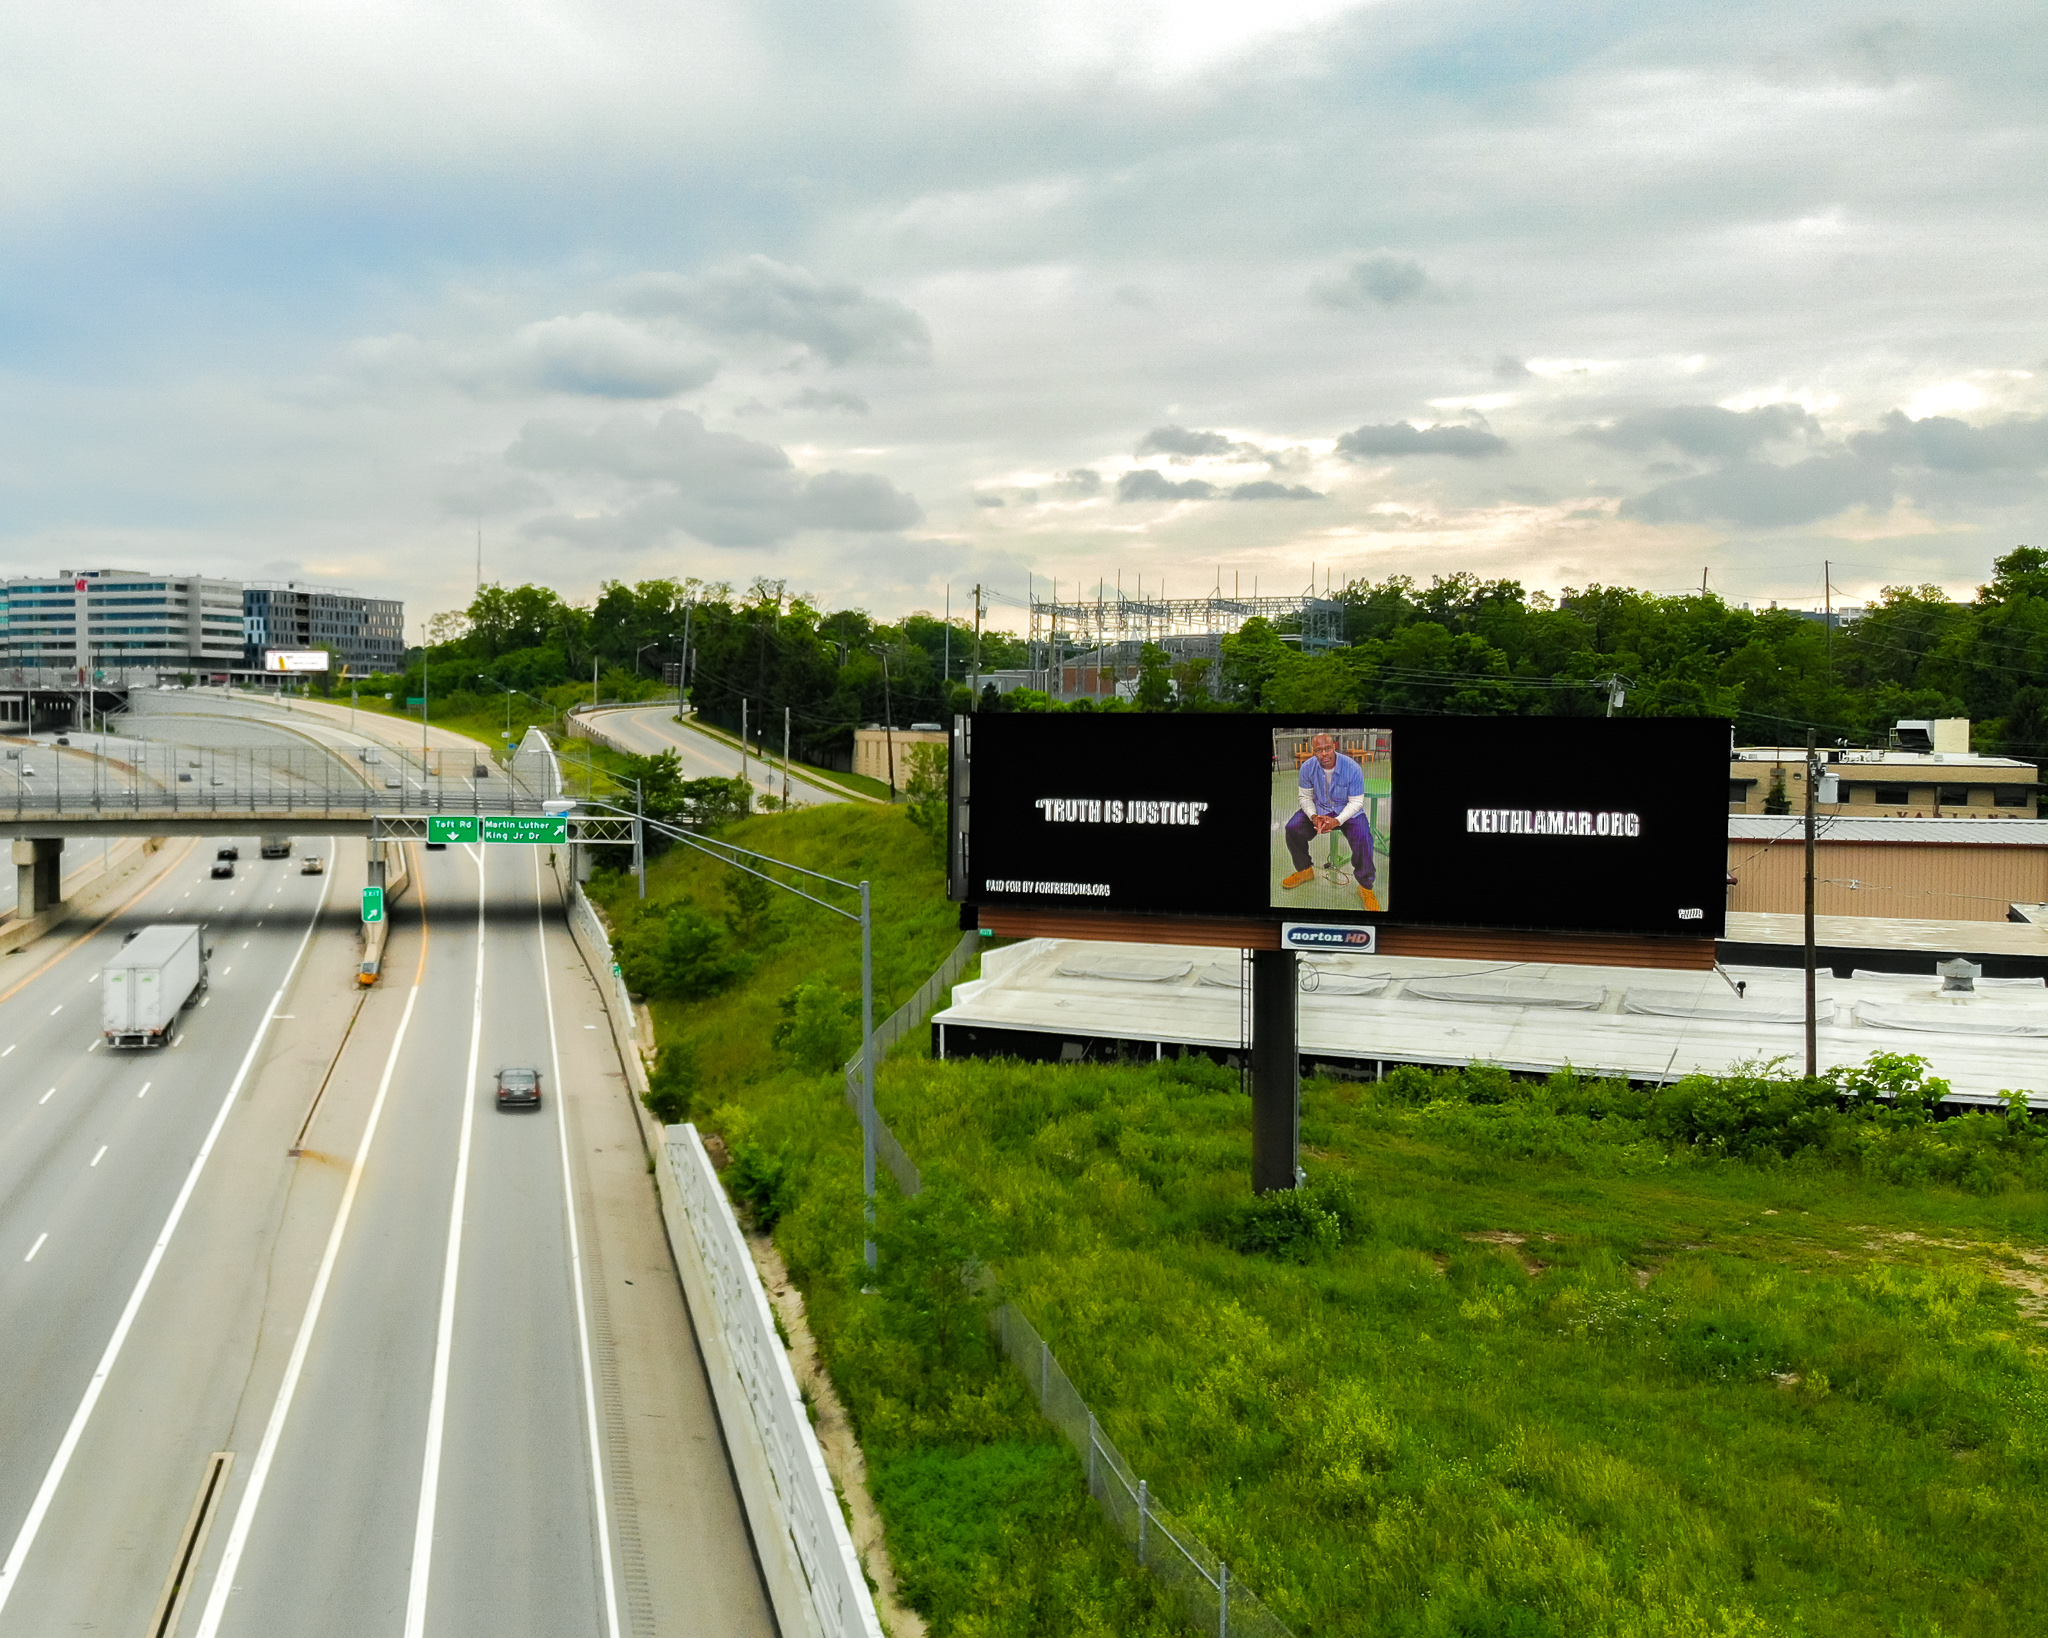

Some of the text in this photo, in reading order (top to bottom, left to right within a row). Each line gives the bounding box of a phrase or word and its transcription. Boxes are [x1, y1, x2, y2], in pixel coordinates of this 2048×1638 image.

[1103, 799, 1124, 824] IS
[435, 820, 472, 828] Taft Rd
[485, 820, 550, 829] Martin Luther
[1466, 808, 1640, 837] KEITHLAMAR.ORG
[485, 831, 540, 841] King Jr Dr
[986, 879, 1111, 897] PAID FOR BY FORFREEDOMS.ORG
[1290, 932, 1367, 944] norton HD
